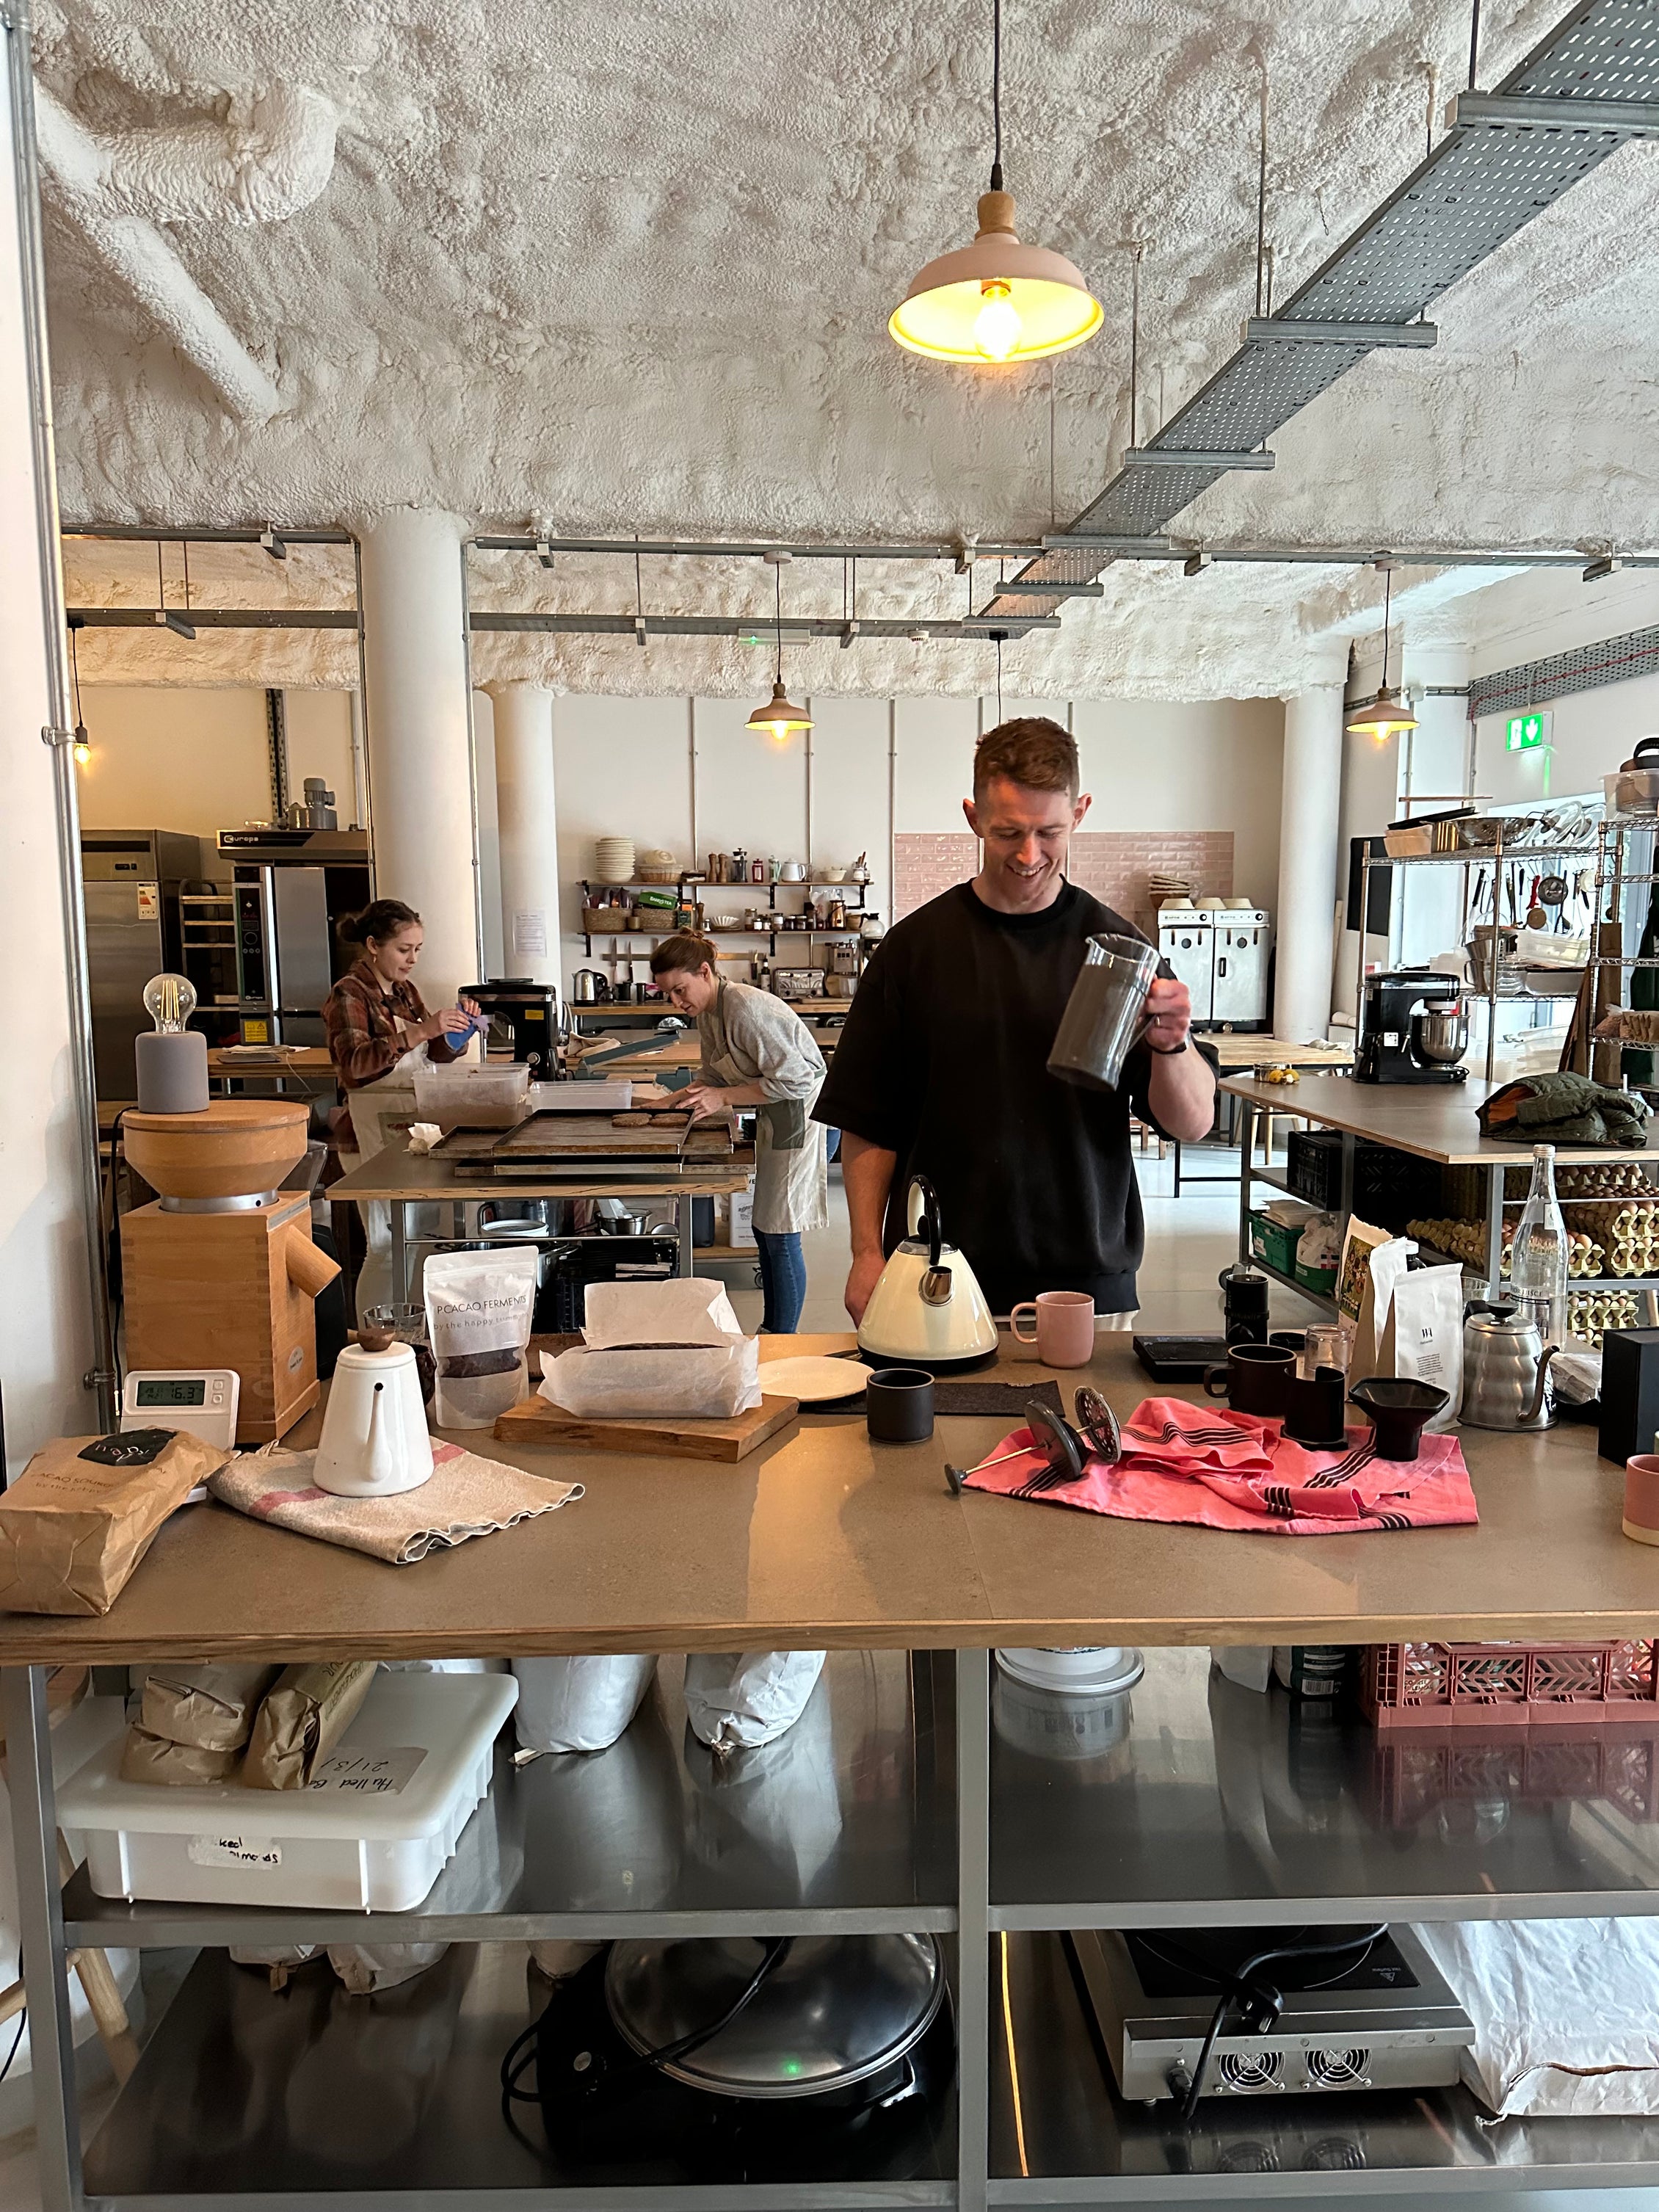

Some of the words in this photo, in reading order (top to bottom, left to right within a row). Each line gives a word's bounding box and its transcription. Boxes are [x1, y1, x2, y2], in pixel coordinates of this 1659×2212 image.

[484, 1295, 526, 1309] FERMENTS
[446, 1321, 462, 1330] the
[465, 1318, 493, 1328] happy
[339, 1777, 393, 1791] Hulled
